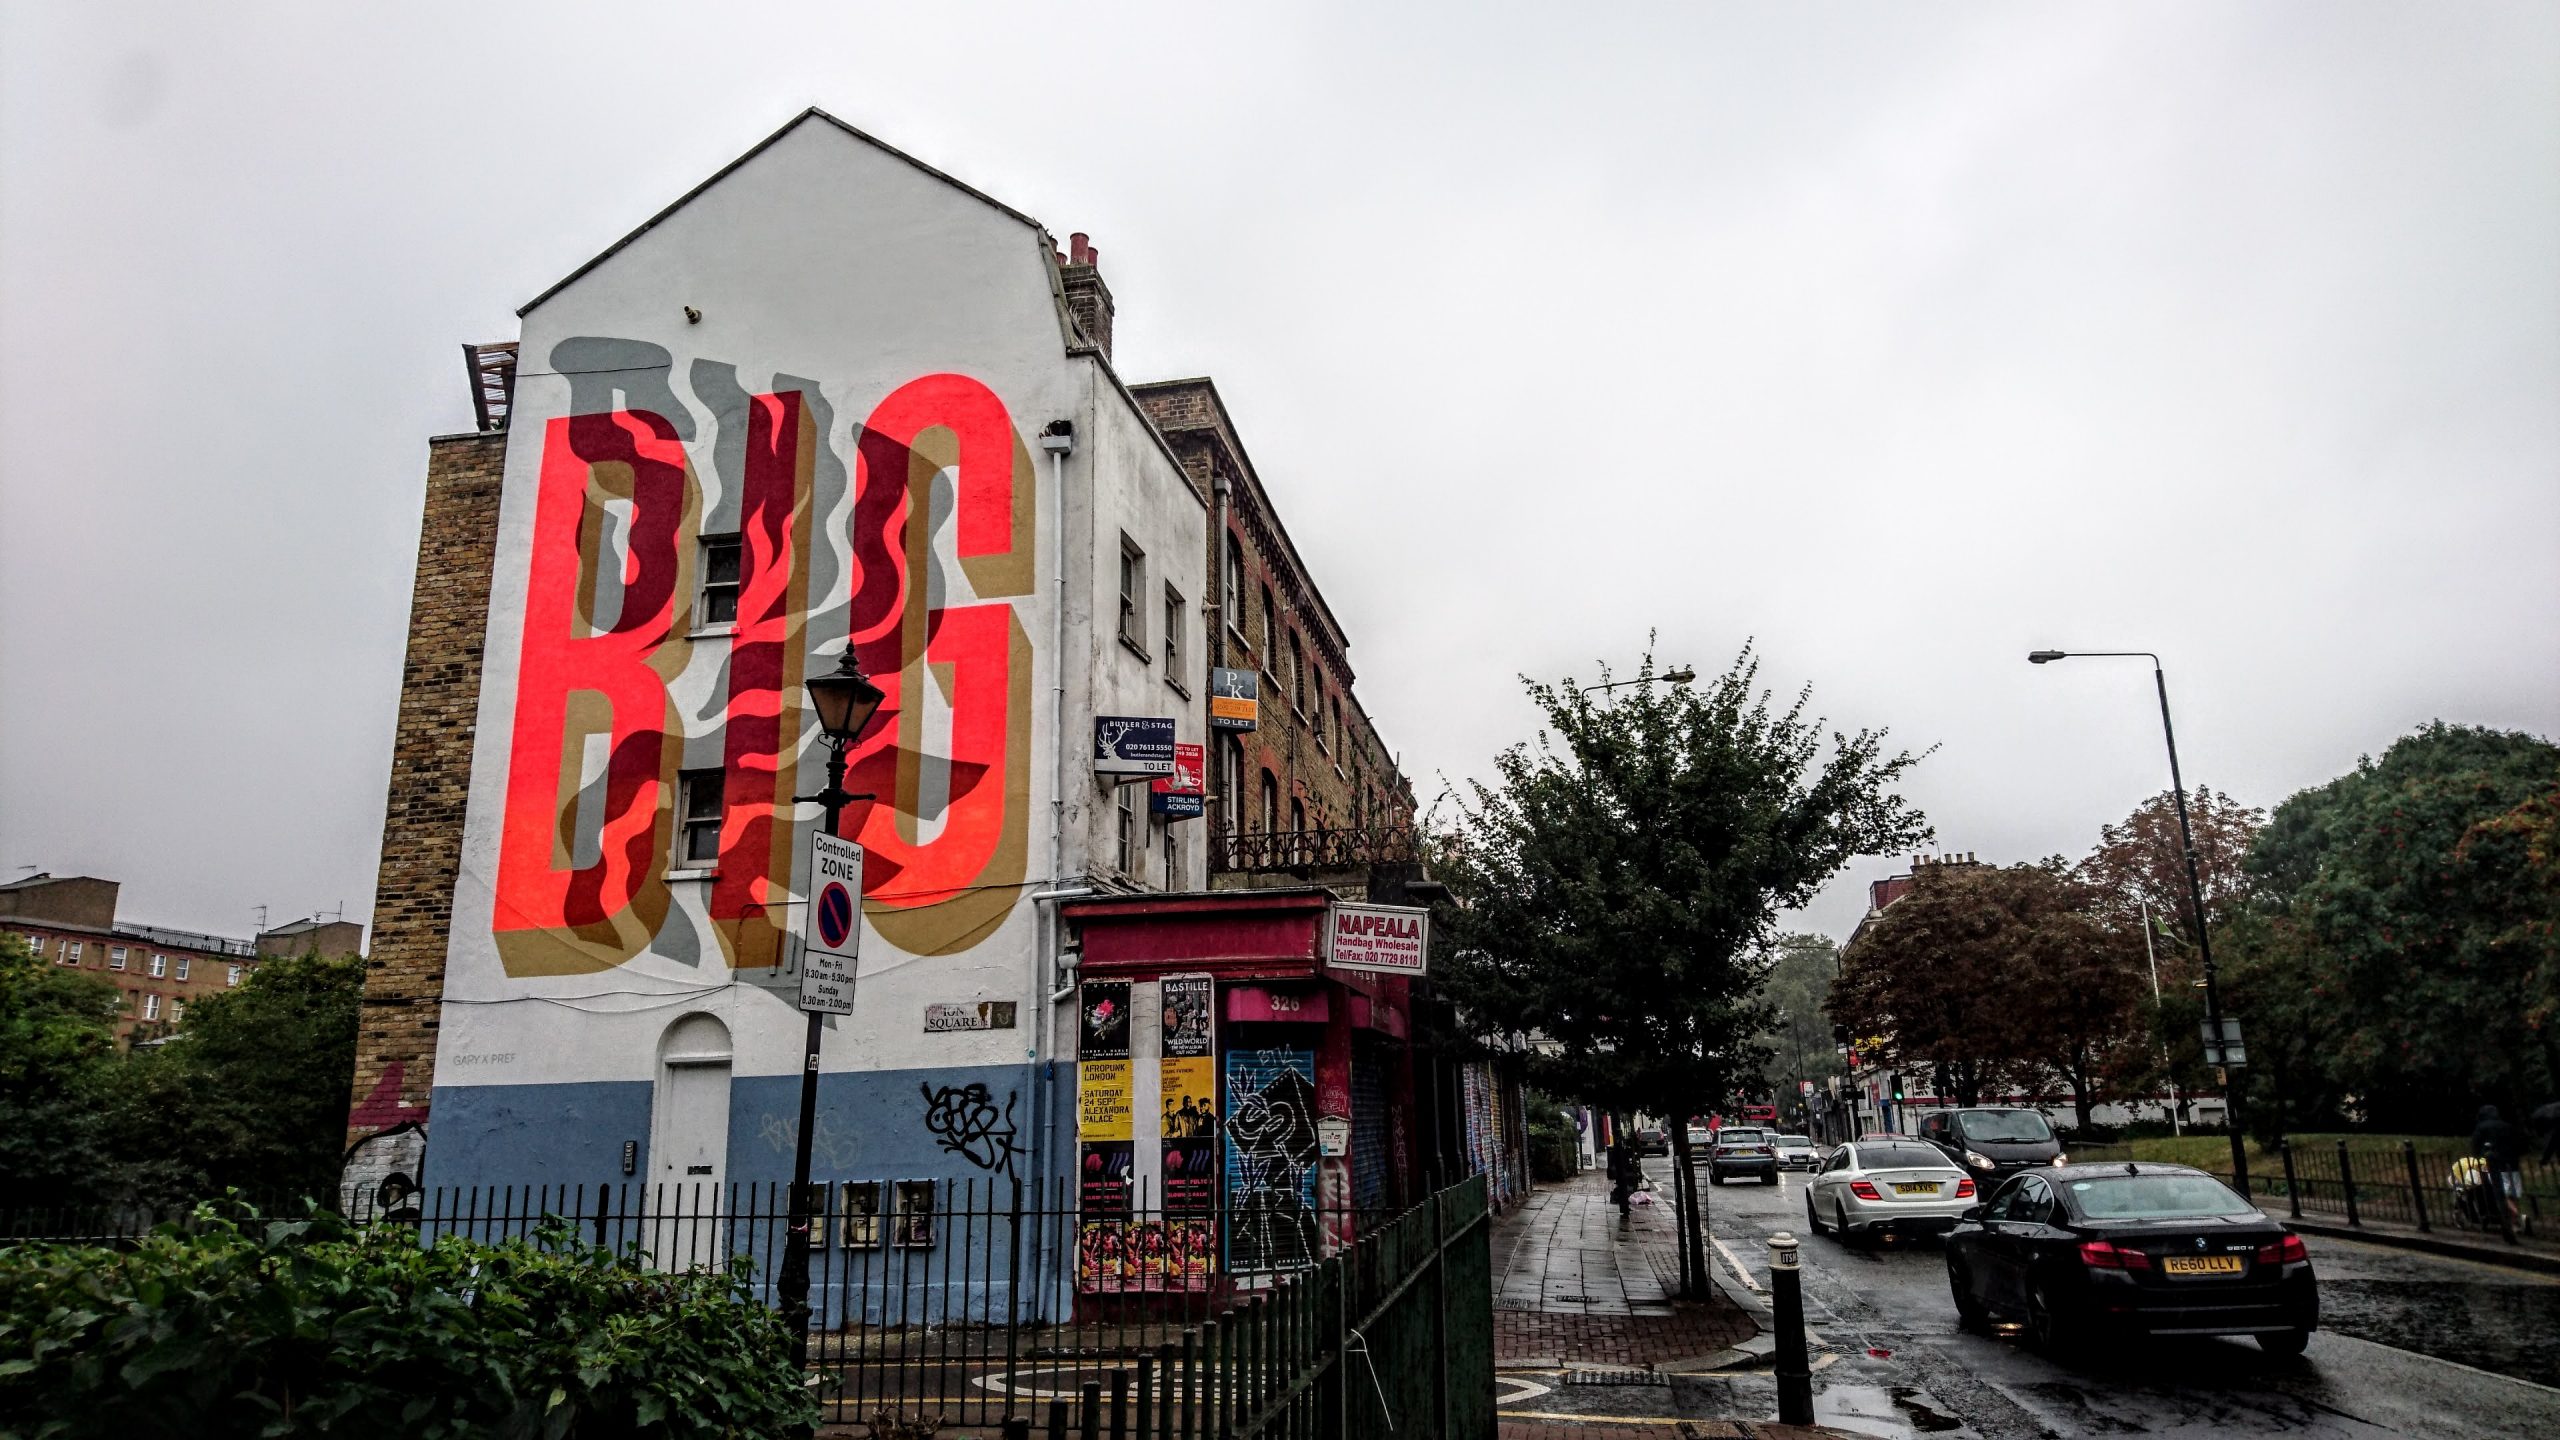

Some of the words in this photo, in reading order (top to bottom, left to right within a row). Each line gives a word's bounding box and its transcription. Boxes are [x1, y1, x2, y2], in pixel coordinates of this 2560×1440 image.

[1109, 720, 1140, 728] BUTLER
[1232, 719, 1250, 727] LET
[1143, 762, 1155, 771] TO
[1156, 763, 1172, 771] LET
[1167, 796, 1200, 805] STIRLING
[1167, 803, 1200, 812] ACKROYD
[816, 837, 861, 862] Controlled
[821, 857, 854, 881] ZONE
[1337, 914, 1420, 940] NAPEALA
[1336, 936, 1373, 950] Handbag
[1375, 939, 1418, 952] Wholesale
[1364, 951, 1379, 963] 020
[1380, 952, 1399, 965] 7729
[1399, 954, 1418, 966] 8118
[817, 984, 839, 997] Sunday
[1271, 995, 1300, 1011] 326
[929, 1017, 977, 1030] SQUARE
[1184, 1037, 1208, 1045] WORLD
[453, 1055, 480, 1066] GARY
[481, 1055, 488, 1064] X
[1084, 1064, 1125, 1073] AFROPUNK
[1084, 1073, 1116, 1081] LONDON
[1084, 1089, 1124, 1098] SATURDAY
[1084, 1098, 1094, 1106] 24
[1097, 1097, 1117, 1106] SEPT
[1084, 1106, 1130, 1115] ALEXANDRA
[1083, 1115, 1114, 1123] PALACE
[2171, 1259, 2206, 1270] RE60
[2208, 1256, 2234, 1270] LLV
